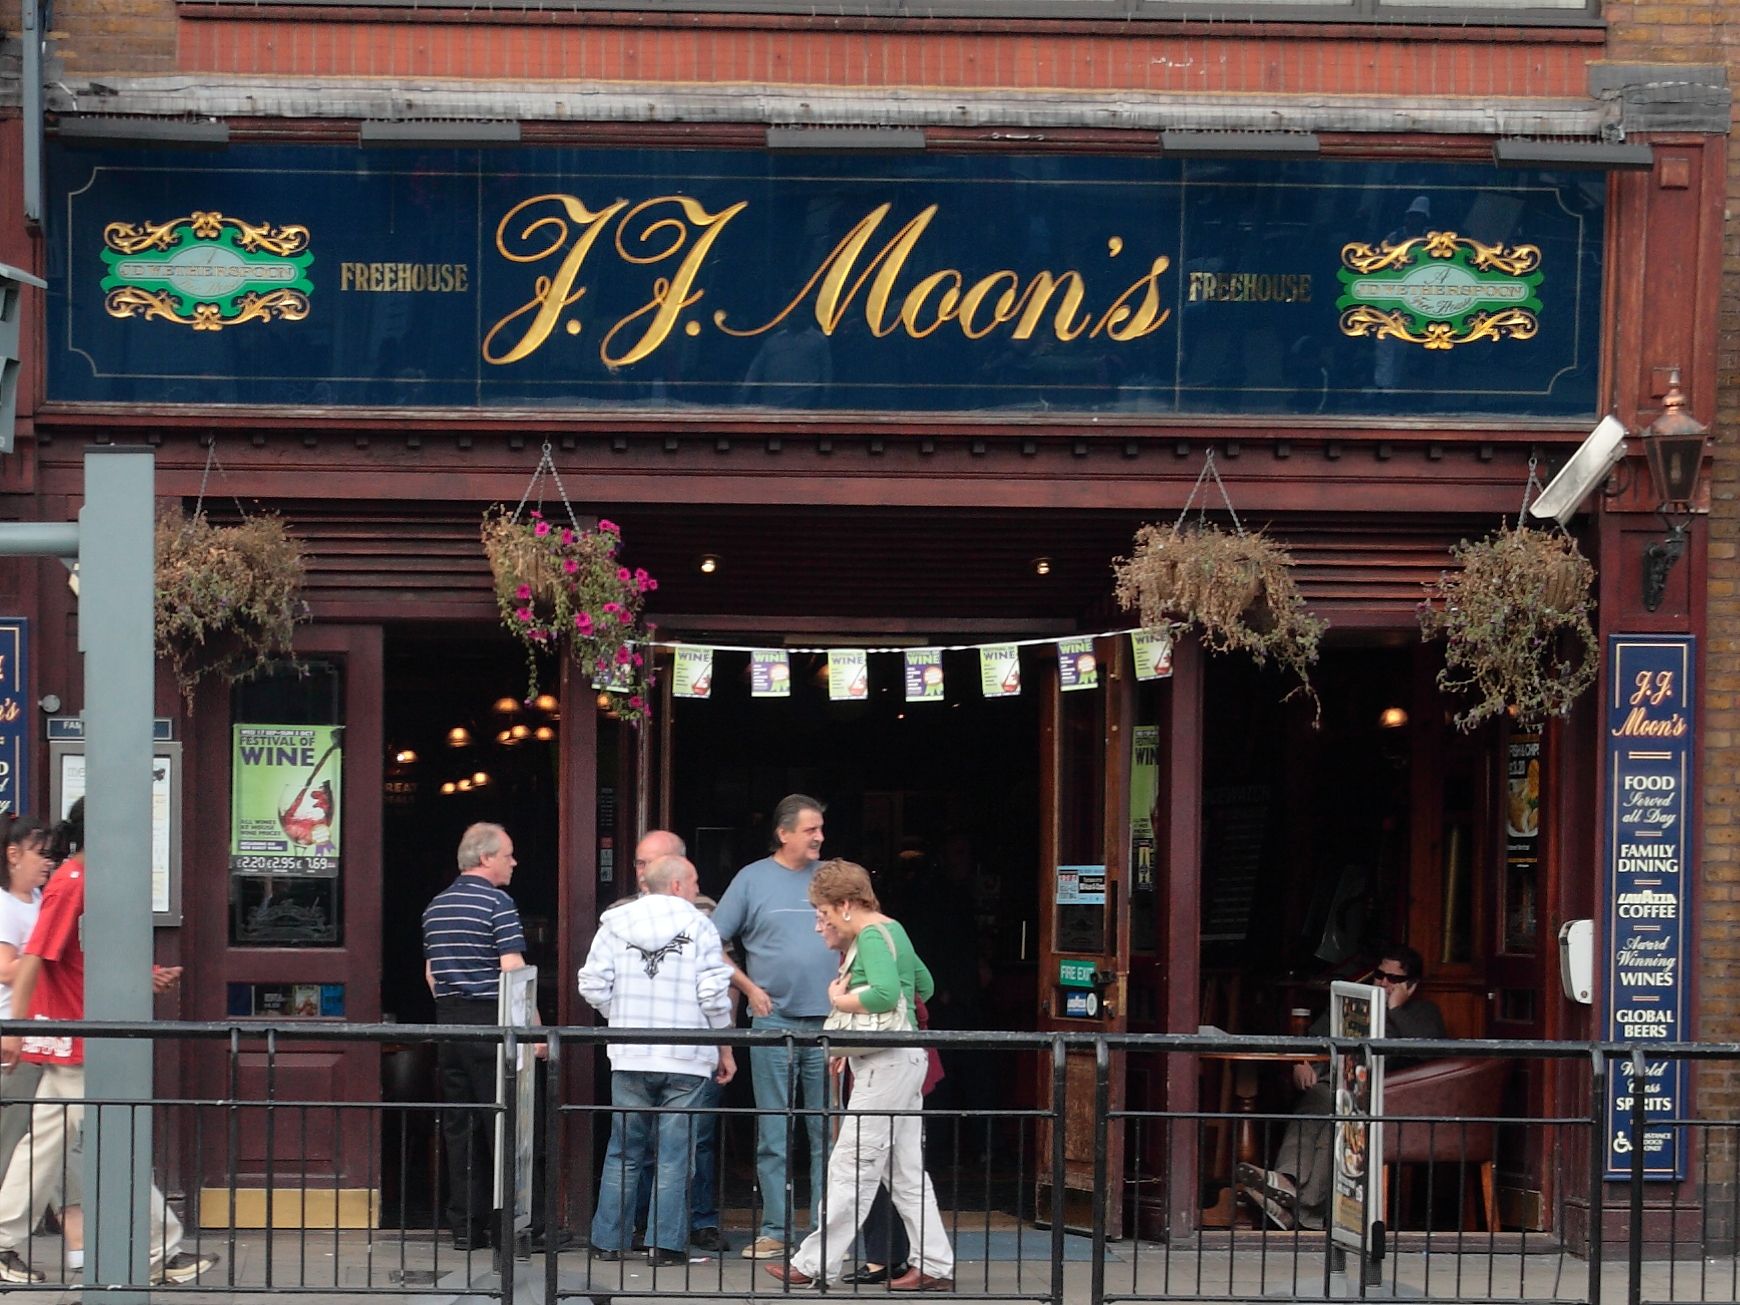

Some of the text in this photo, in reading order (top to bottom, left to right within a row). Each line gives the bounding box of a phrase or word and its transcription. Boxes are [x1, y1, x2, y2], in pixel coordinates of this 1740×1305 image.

[340, 262, 468, 293] FREEHOUSE
[713, 201, 1172, 342] Moon's
[1188, 272, 1312, 302] FREEHOUSE
[1381, 284, 1524, 298] WETHERSPOON
[983, 650, 1017, 660] WINE
[1059, 642, 1094, 654] WINE
[679, 653, 711, 662] WINE
[754, 654, 788, 662] WINE
[832, 656, 864, 665] WINE
[907, 654, 940, 665] WINE
[1612, 707, 1687, 737] Moon's
[240, 736, 315, 747] FESTIVAL OF
[240, 747, 315, 766] WINE
[1136, 747, 1160, 765] WIN
[1624, 776, 1675, 790] FOOD
[1623, 792, 1676, 807] Served
[1622, 809, 1677, 829] all Day
[1620, 844, 1676, 858] FAMILY
[1618, 859, 1679, 873] DINING
[1618, 905, 1676, 919] COFFEE
[1622, 936, 1671, 951] Award
[1616, 950, 1677, 972] Winning
[1620, 972, 1674, 986] WINES
[1616, 1009, 1675, 1023] GLOBAL
[1624, 1024, 1667, 1038] BEERS
[1620, 1061, 1669, 1077] Wrld
[1627, 1079, 1661, 1093] Cass
[1616, 1097, 1673, 1111] SPITS
